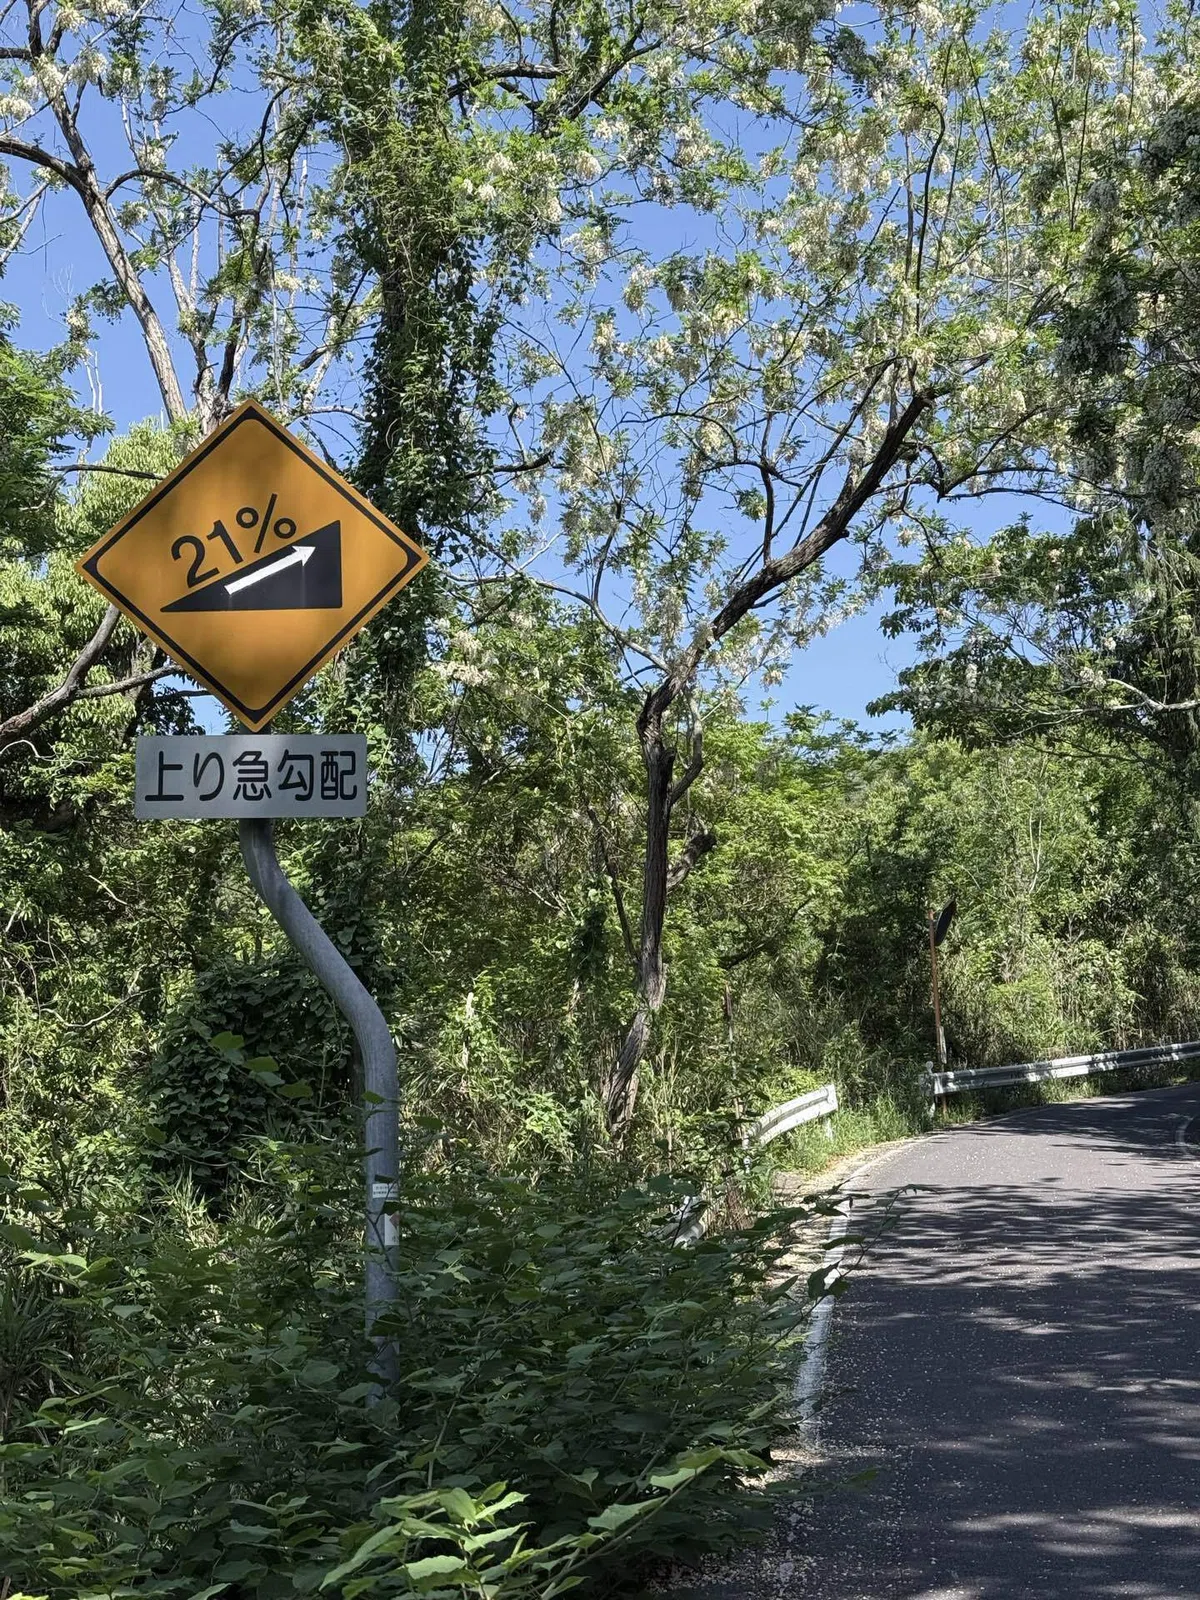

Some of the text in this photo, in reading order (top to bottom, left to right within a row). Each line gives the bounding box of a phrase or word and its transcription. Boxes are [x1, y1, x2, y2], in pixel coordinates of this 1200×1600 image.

[170, 493, 297, 588] 21%
[144, 749, 357, 801] 上り急勾配
